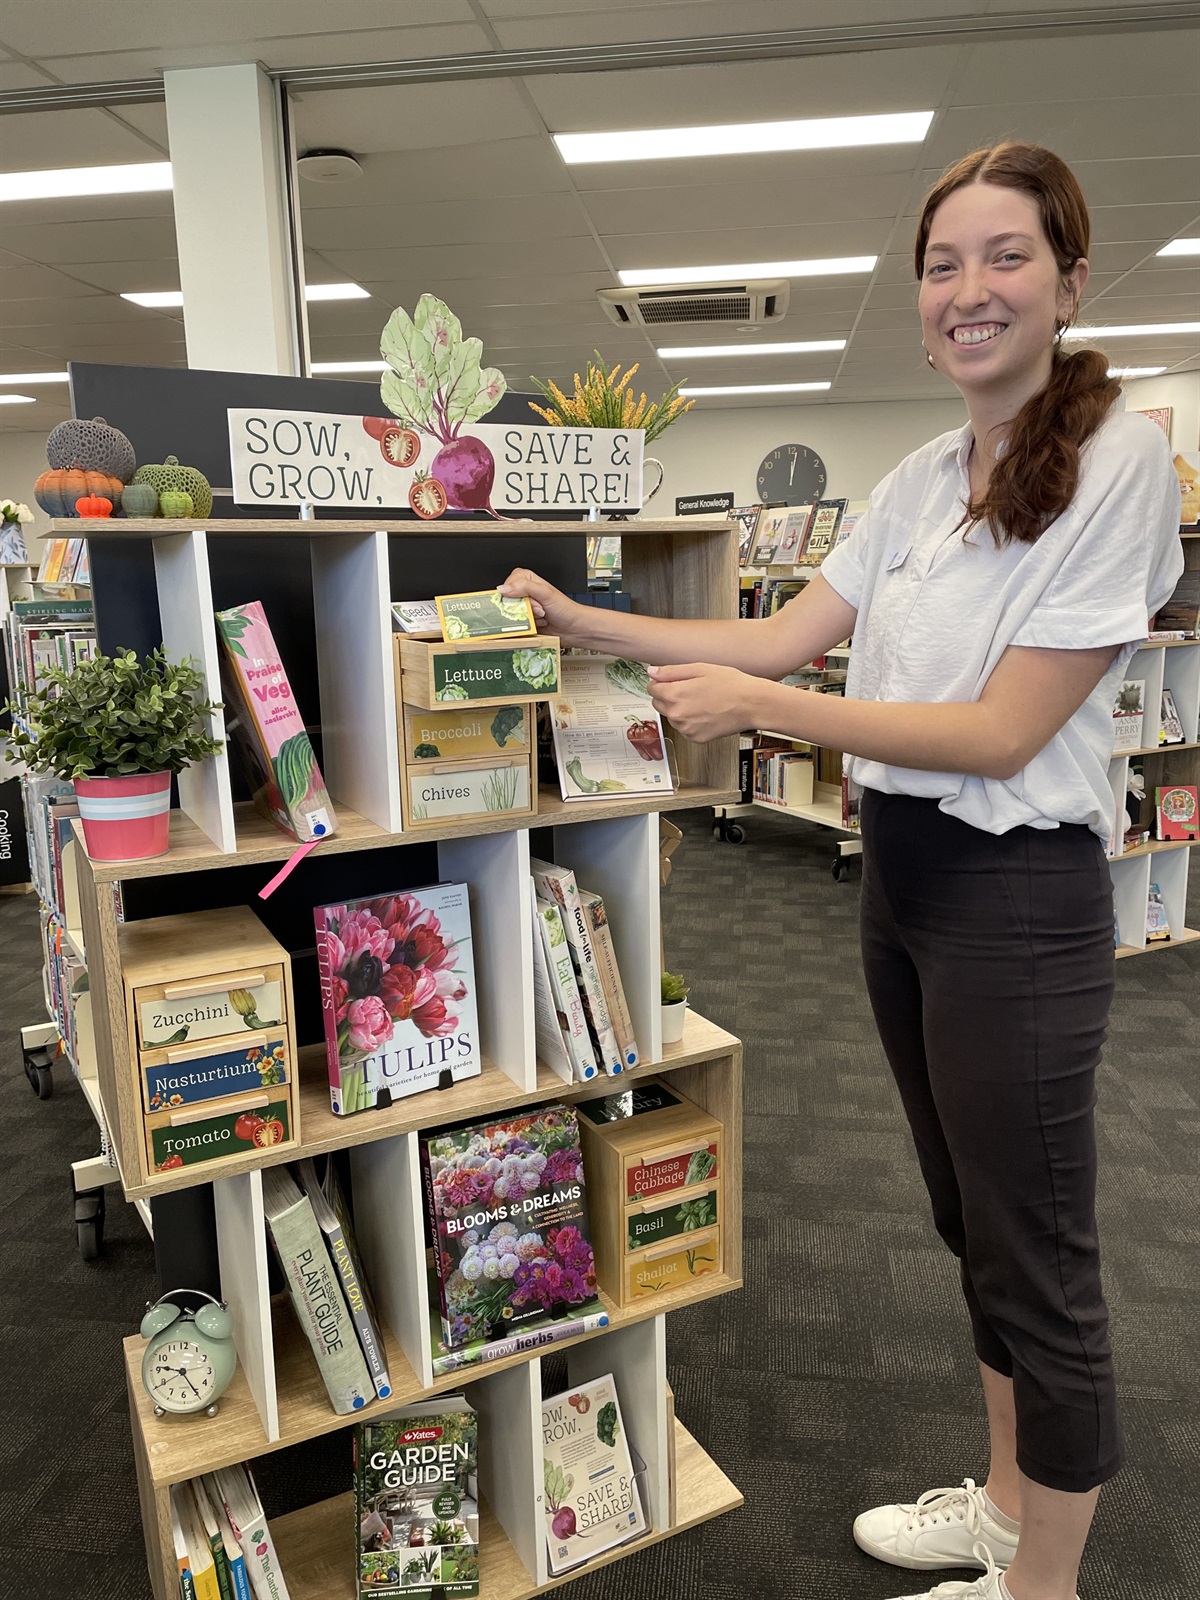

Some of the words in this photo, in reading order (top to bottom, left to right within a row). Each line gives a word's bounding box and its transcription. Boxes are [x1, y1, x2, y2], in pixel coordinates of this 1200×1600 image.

[245, 417, 351, 461] SOW,
[504, 430, 593, 466] SAVE
[610, 433, 632, 466] &
[774, 451, 781, 459] 11
[787, 446, 797, 455] 12
[764, 461, 774, 470] 10
[813, 459, 820, 468] 2
[249, 463, 384, 505] GROW,
[504, 471, 629, 504] SHARE!
[758, 476, 765, 485] 9
[818, 474, 825, 483] 3
[762, 491, 769, 499] 8
[813, 489, 820, 497] 4
[678, 500, 699, 510] General
[699, 497, 730, 508] Knowledge
[402, 604, 432, 618] seed
[445, 600, 481, 613] Lettuce
[245, 663, 283, 681] Praise
[252, 657, 265, 669] In
[271, 673, 283, 686] of
[443, 666, 503, 684] Lettuce
[252, 680, 291, 703] Veg
[264, 709, 298, 726] zaslavsky
[270, 705, 288, 716] alice
[1115, 724, 1141, 736] PERRY
[1118, 716, 1139, 726] ANNE
[420, 722, 483, 742] Broccoli
[421, 785, 471, 802] Chives
[0, 809, 12, 860] Cooking
[573, 907, 586, 934] food
[582, 942, 593, 964] life
[316, 924, 333, 1010] TULIPS
[556, 956, 573, 987] Eat
[565, 985, 575, 1000] for
[589, 965, 601, 999] michelle
[597, 999, 610, 1031] bridges
[152, 1003, 230, 1029] Zucchini
[569, 993, 583, 1038] Beauty
[353, 1032, 472, 1086] TULIPS
[155, 1061, 258, 1092] Nasturtium
[386, 1077, 413, 1088] varieties
[424, 1069, 440, 1078] home
[453, 1060, 473, 1071] garden
[163, 1128, 231, 1153] Tomato
[634, 1161, 680, 1181] Chinese
[634, 1171, 684, 1193] Cabbage
[446, 1206, 508, 1234] BLOOMS
[510, 1204, 522, 1217] &
[522, 1185, 582, 1213] DREAMS
[424, 1167, 435, 1217] BLOOMS
[432, 1226, 442, 1278] DREAMS
[535, 1218, 560, 1229] CONNECTION
[635, 1216, 665, 1235] Basil
[319, 1263, 330, 1283] THE
[333, 1237, 355, 1280] PLANT
[346, 1281, 364, 1315] LOVE
[636, 1262, 678, 1285] Shallot
[296, 1248, 327, 1303] PLANT
[314, 1303, 344, 1355] GUIDE
[324, 1281, 343, 1324] ESSENTIAL
[168, 1344, 176, 1352] 11
[180, 1341, 189, 1350] 12
[487, 1342, 516, 1360] grow
[515, 1331, 554, 1351] herbs
[158, 1354, 168, 1362] 10
[202, 1354, 208, 1363] 2
[367, 1344, 381, 1373] FOWLER
[155, 1366, 161, 1374] 9
[206, 1366, 212, 1375] 3
[160, 1378, 167, 1386] 8
[168, 1387, 174, 1396] 7
[201, 1378, 208, 1386] 4
[181, 1390, 187, 1399] 6
[412, 1430, 437, 1440] Yates
[370, 1442, 469, 1471] GARDEN
[384, 1463, 456, 1488] GUIDE
[576, 1482, 615, 1512] SAVE
[619, 1476, 630, 1491] &
[580, 1491, 633, 1528] SHARE!
[260, 1553, 271, 1573] The
[183, 1578, 191, 1590] the
